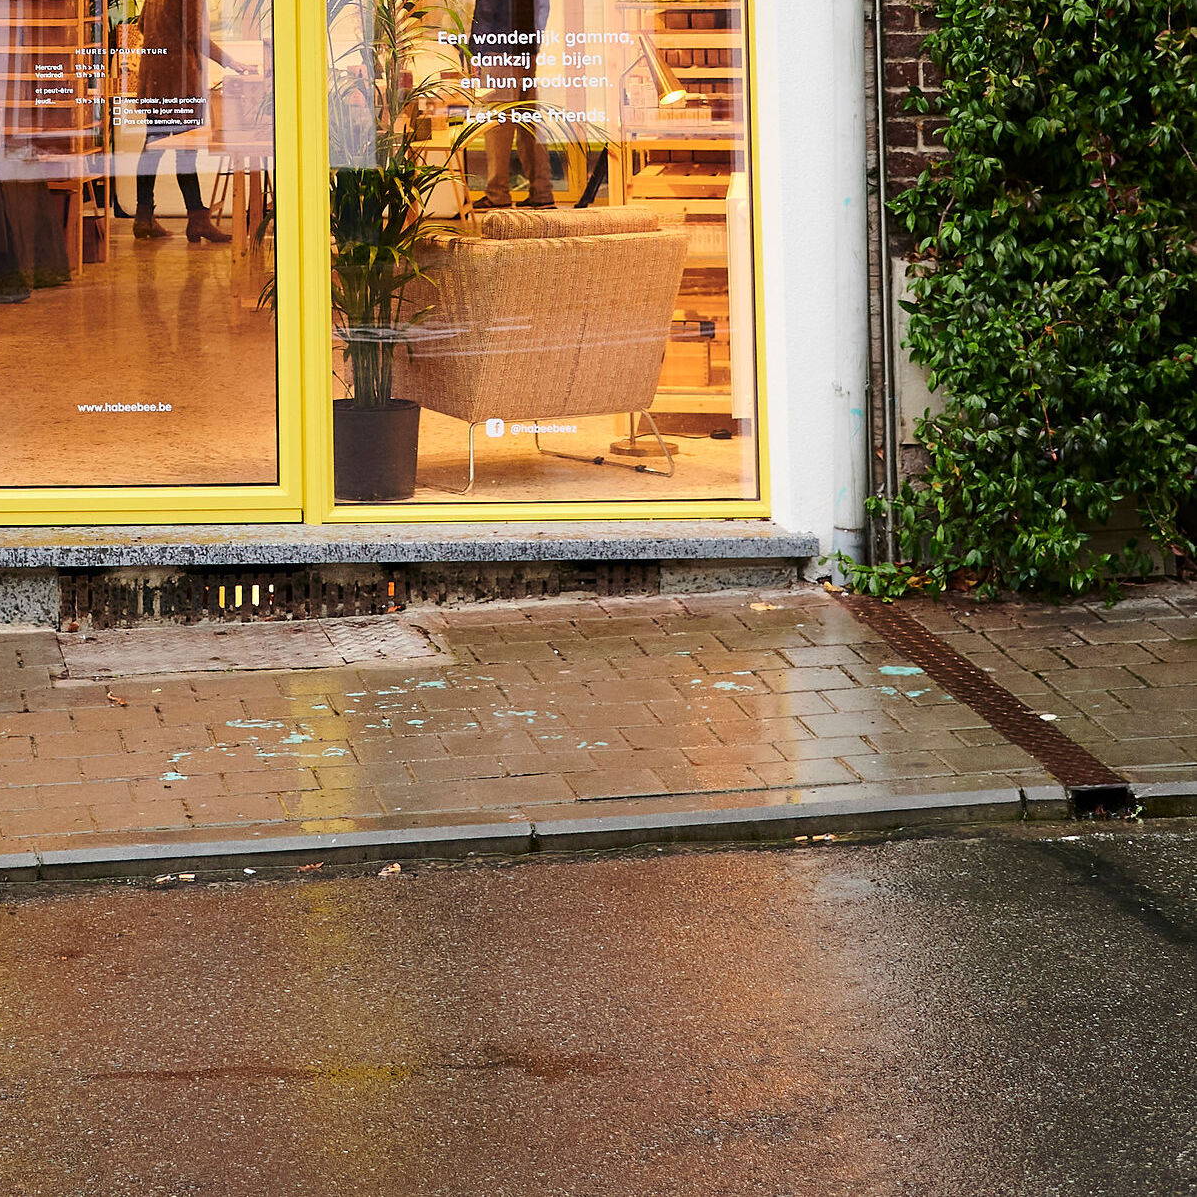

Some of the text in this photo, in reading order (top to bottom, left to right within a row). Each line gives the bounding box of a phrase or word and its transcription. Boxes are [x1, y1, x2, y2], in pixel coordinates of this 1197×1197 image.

[437, 30, 634, 48] Een wonderlijk gamma,
[471, 52, 602, 69] dankzij de bijen
[460, 75, 614, 91] en hun producten.
[179, 97, 207, 105] prochain
[511, 109, 542, 123] bee
[546, 109, 610, 123] friends.
[77, 402, 172, 412] www.habeebee.be
